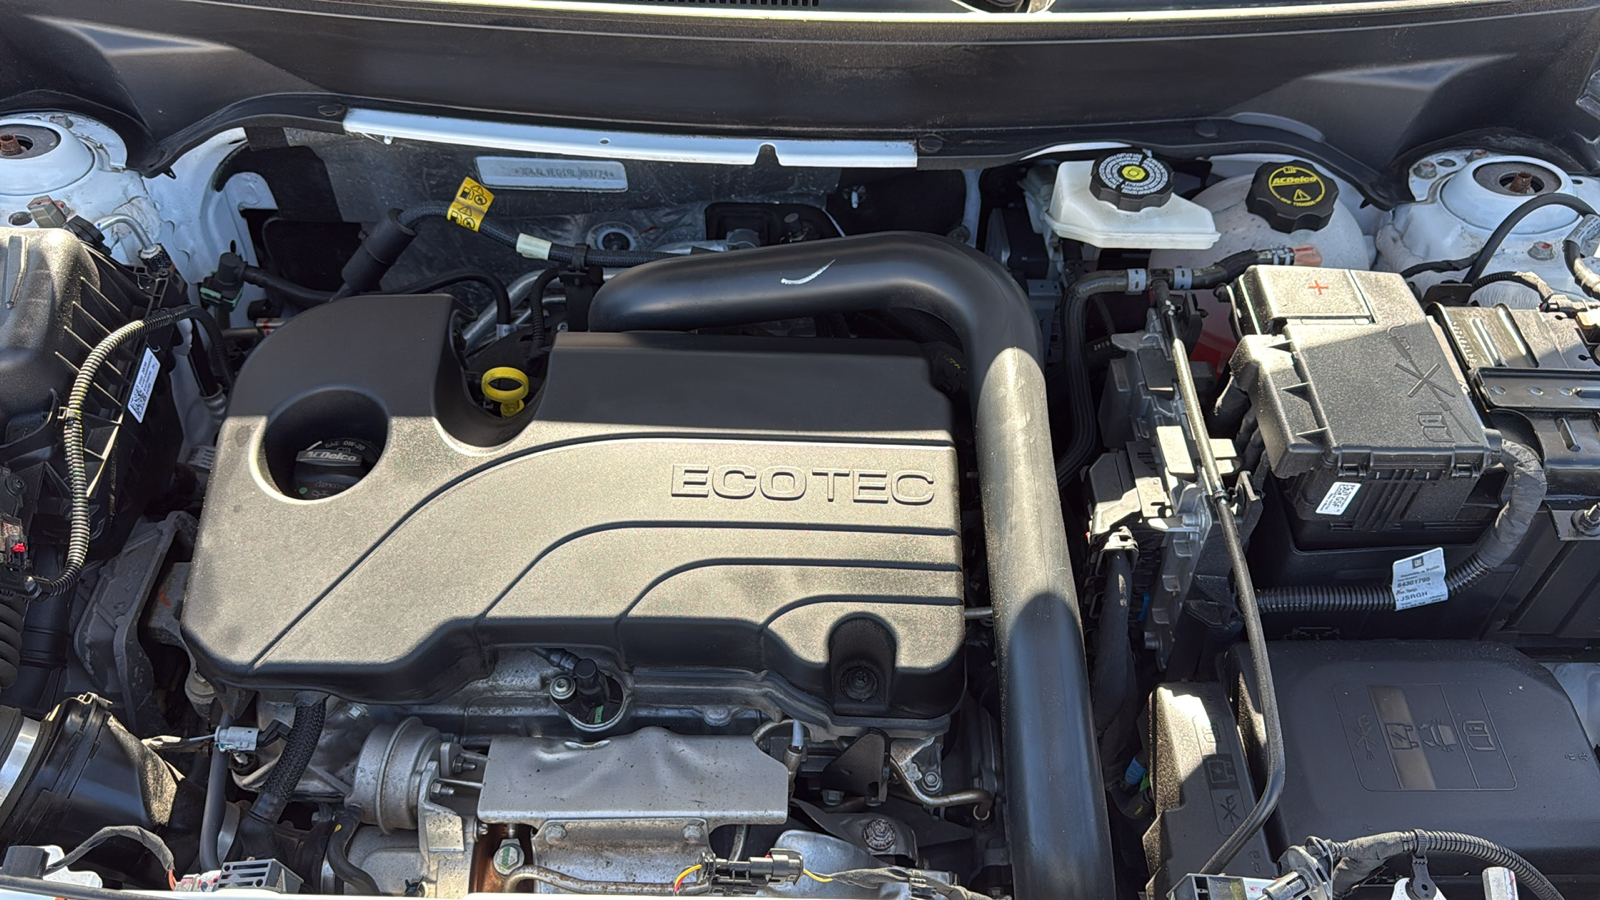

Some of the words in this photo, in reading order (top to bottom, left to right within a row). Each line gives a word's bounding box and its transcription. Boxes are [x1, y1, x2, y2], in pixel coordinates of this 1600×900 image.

[1272, 176, 1317, 185] ACDelco
[343, 440, 366, 451] 0W-20
[305, 451, 357, 461] ACDelco
[671, 464, 935, 506] ECOTEC
